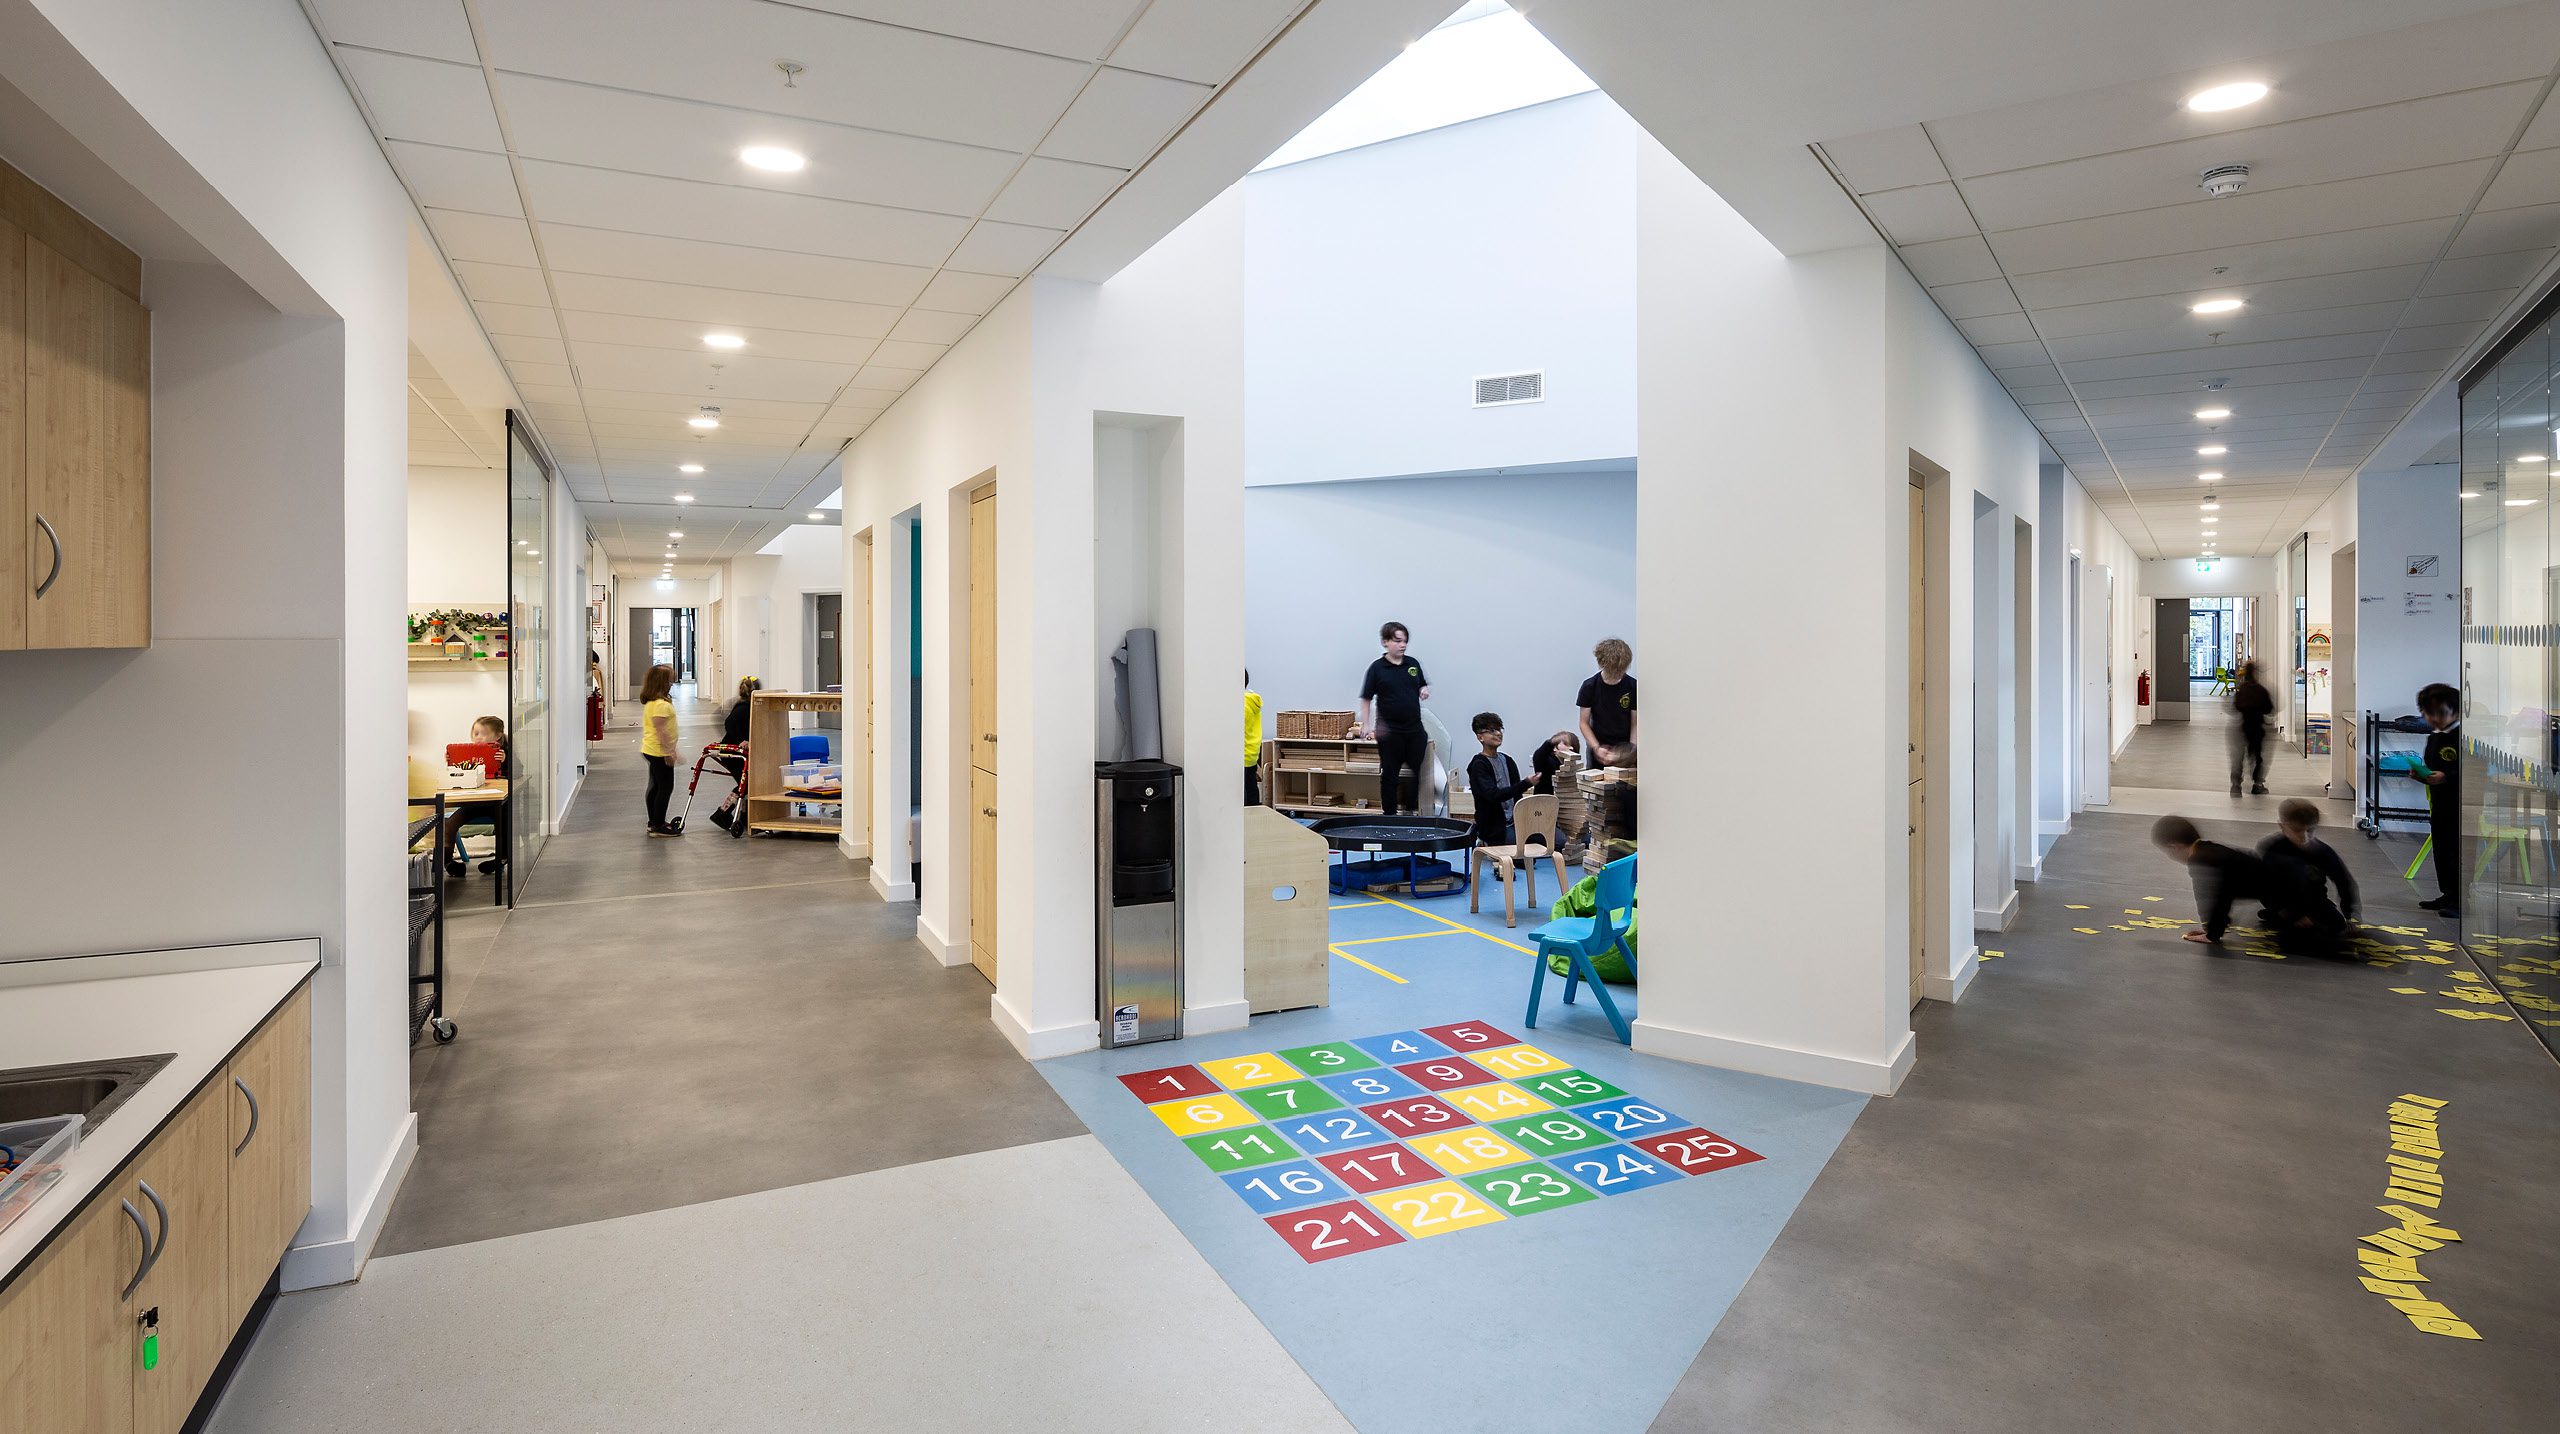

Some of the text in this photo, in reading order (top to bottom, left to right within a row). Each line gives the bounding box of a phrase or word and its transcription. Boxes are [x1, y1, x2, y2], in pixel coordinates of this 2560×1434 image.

[2464, 661, 2471, 719] 5
[1159, 1028, 1488, 1090] 1 2 3 4 5
[1186, 1052, 1549, 1123] 6 7 8 9 10
[1211, 1077, 1602, 1160] 11 12 13 14 15
[1245, 1106, 1666, 1200] 16 17 18 19 20
[1294, 1136, 1737, 1250] 21 22 23 24 25
[2428, 1321, 2452, 1331] 0
